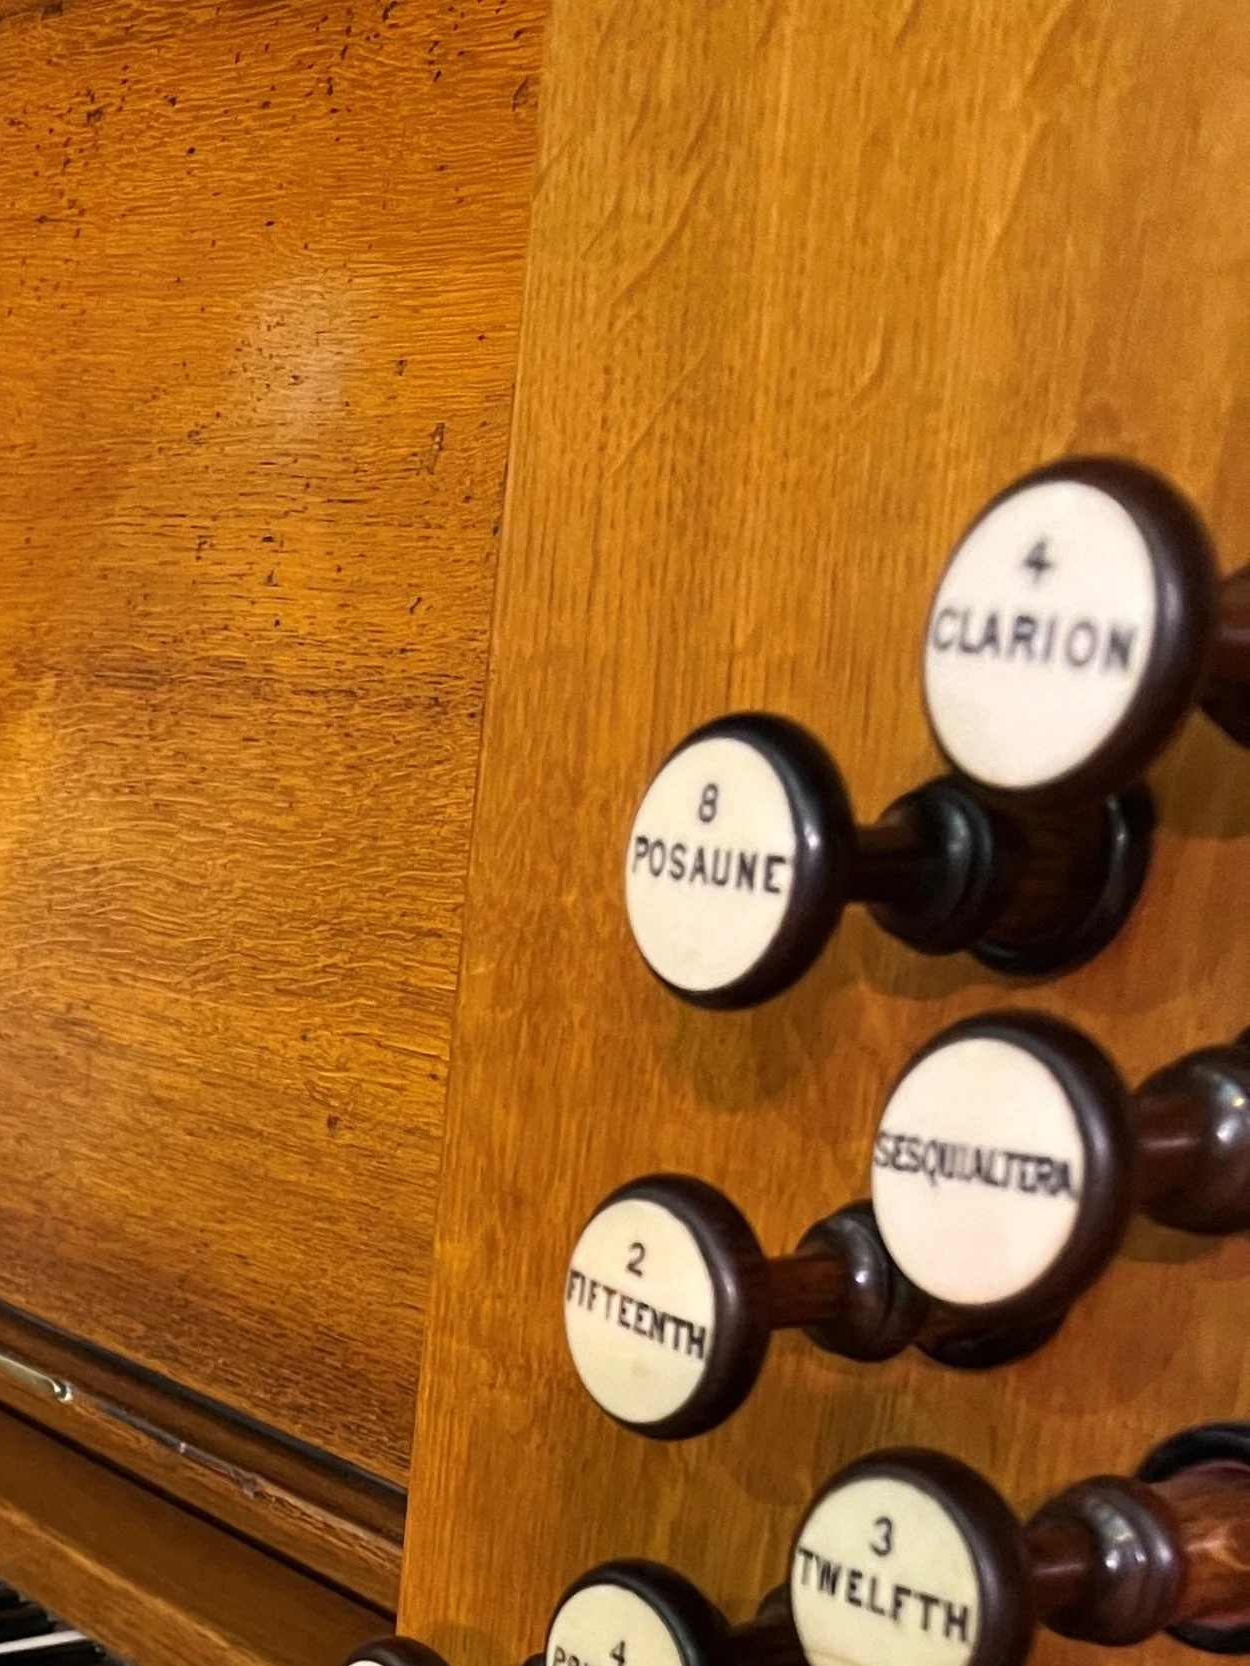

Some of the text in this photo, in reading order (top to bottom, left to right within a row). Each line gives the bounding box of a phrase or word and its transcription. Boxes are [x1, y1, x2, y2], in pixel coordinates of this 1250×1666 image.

[1021, 539, 1053, 584] 4
[930, 607, 1137, 673] CLARION
[697, 782, 720, 824] 8
[632, 835, 789, 896] POSAUNE
[626, 1242, 646, 1277] 2
[566, 1269, 707, 1360] FIFTEENTH
[870, 1515, 894, 1557] 3
[798, 1547, 969, 1642] TWELFTH
